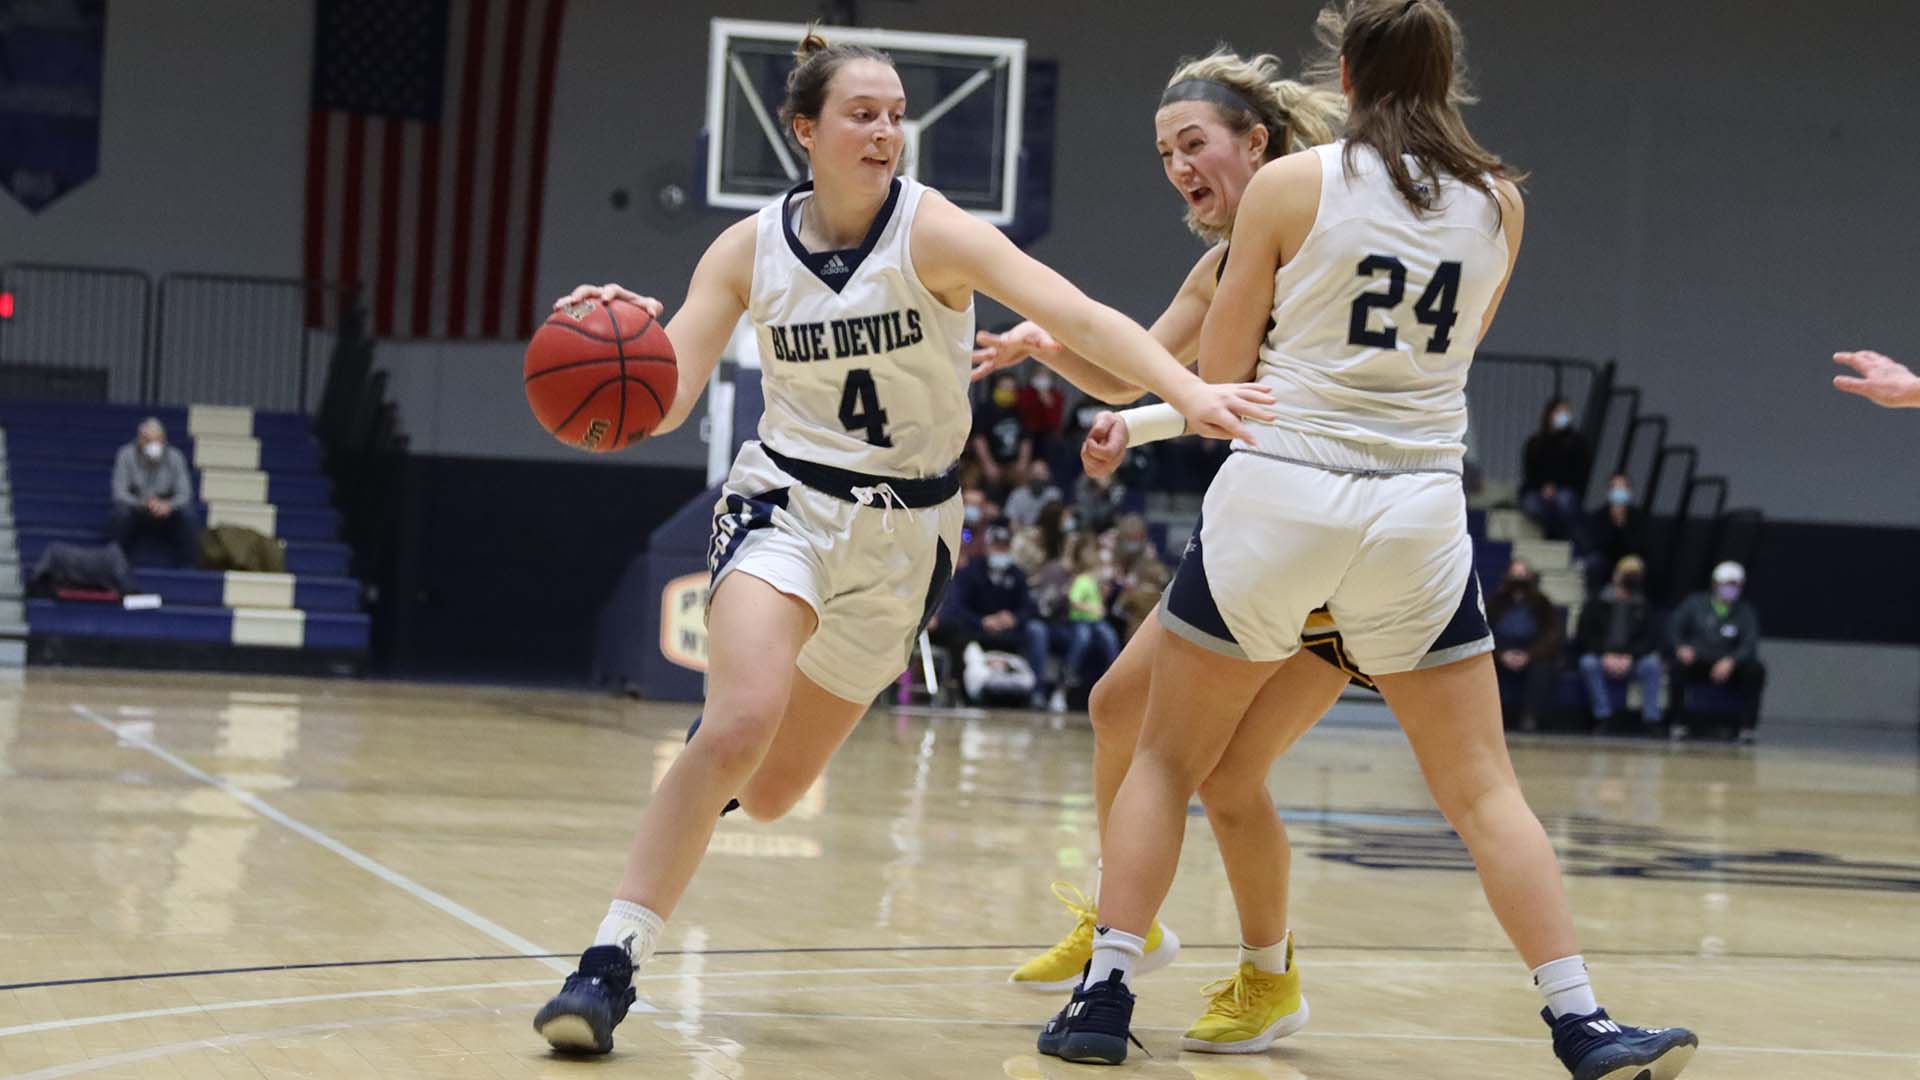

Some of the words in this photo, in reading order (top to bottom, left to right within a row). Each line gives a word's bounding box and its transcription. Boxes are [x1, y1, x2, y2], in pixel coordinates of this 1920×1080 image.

[820, 265, 850, 275] adidas
[1348, 254, 1462, 353] 24
[771, 322, 830, 363] BLUE
[830, 308, 923, 359] DEVILS
[838, 368, 894, 449] 4
